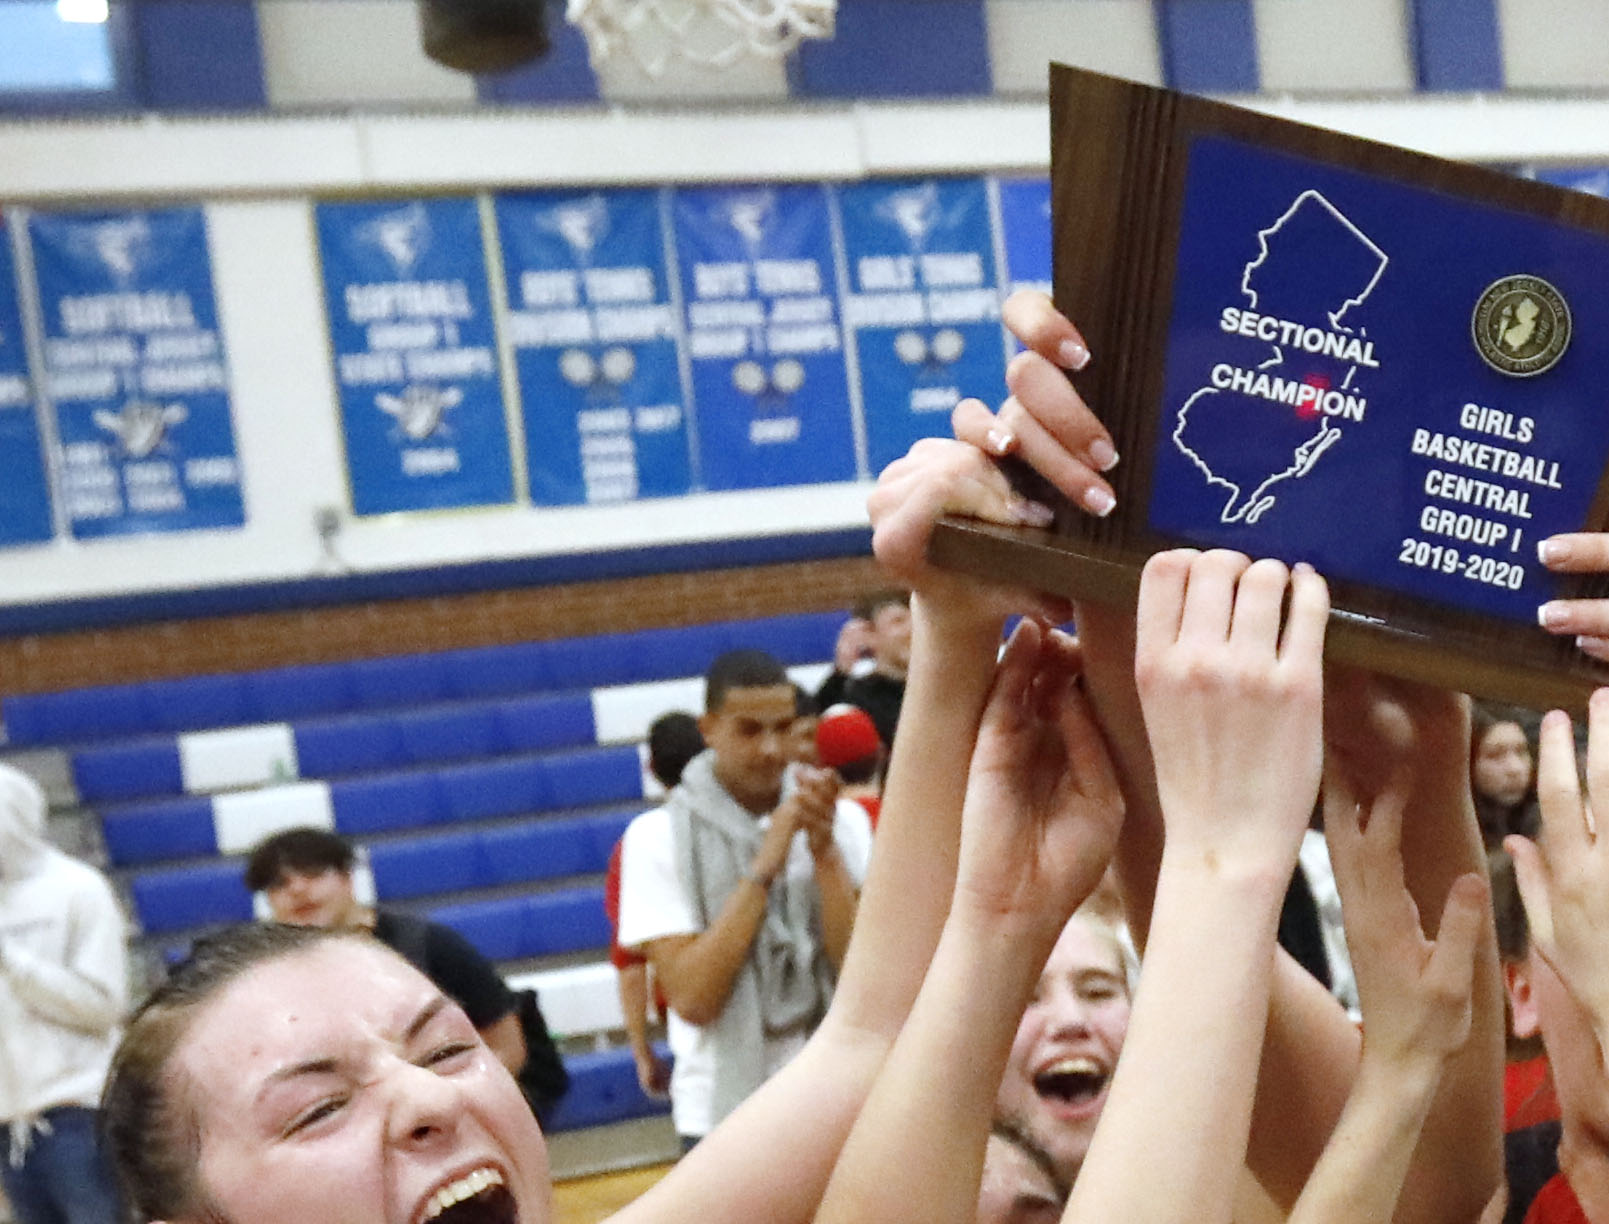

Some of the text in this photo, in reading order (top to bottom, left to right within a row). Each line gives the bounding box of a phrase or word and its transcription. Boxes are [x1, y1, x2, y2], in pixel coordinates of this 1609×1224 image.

[1220, 306, 1380, 367] SECTIONAL
[1211, 363, 1366, 422] CHAMPION
[1460, 402, 1535, 443] GIRLS
[1411, 428, 1562, 490] BASKETBALL
[1425, 469, 1533, 519] CENTRAL
[1420, 506, 1522, 553] GROUP I
[1399, 538, 1525, 590] 2019-2020
